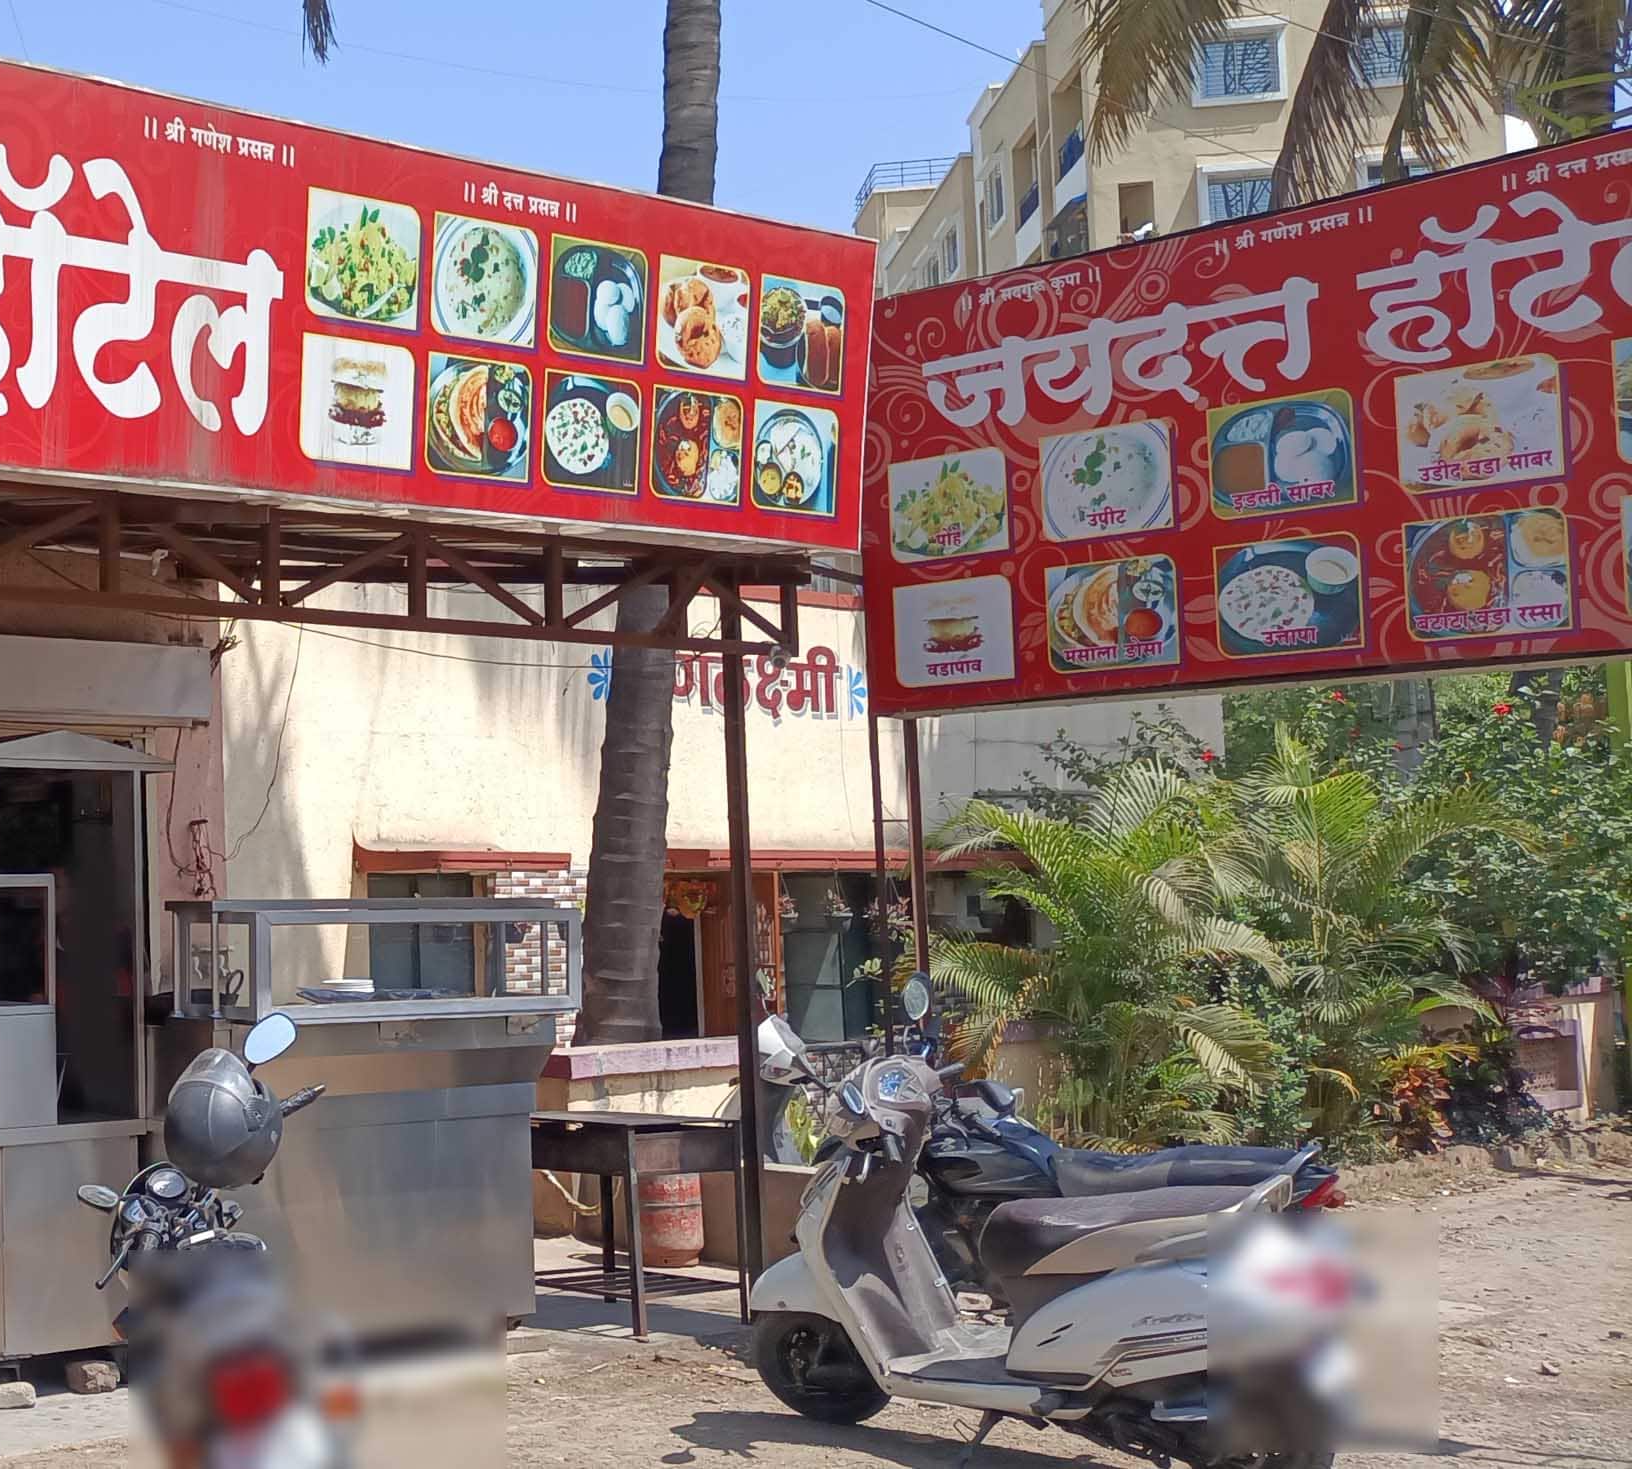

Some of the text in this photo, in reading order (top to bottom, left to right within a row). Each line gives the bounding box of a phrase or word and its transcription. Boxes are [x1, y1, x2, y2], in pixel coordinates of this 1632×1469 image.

[165, 117, 186, 144] श्री
[190, 123, 232, 154] गणेश
[236, 137, 275, 162] प्रसन्न
[1526, 163, 1550, 184] श्री
[1555, 158, 1588, 178] दत्त
[481, 182, 498, 207] श्री
[502, 191, 524, 211] दत्त
[527, 196, 560, 218] प्रसन्न
[1234, 232, 1255, 249] श्री
[1261, 223, 1302, 245] गणेश
[1310, 212, 1349, 234] प्रसन्न
[978, 288, 996, 305] श्री
[1051, 272, 1081, 297] कृपा
[922, 191, 1632, 427] जयदत्त हॉटे
[1418, 447, 1554, 482] उडीद वडा सांबर
[1231, 479, 1335, 512] इडली सांबर
[1087, 507, 1127, 528] उपीट
[1415, 603, 1562, 632] बटाटा वडा रस्सा
[1063, 637, 1164, 663] मसाला डोसा
[926, 658, 982, 678] वडापाव
